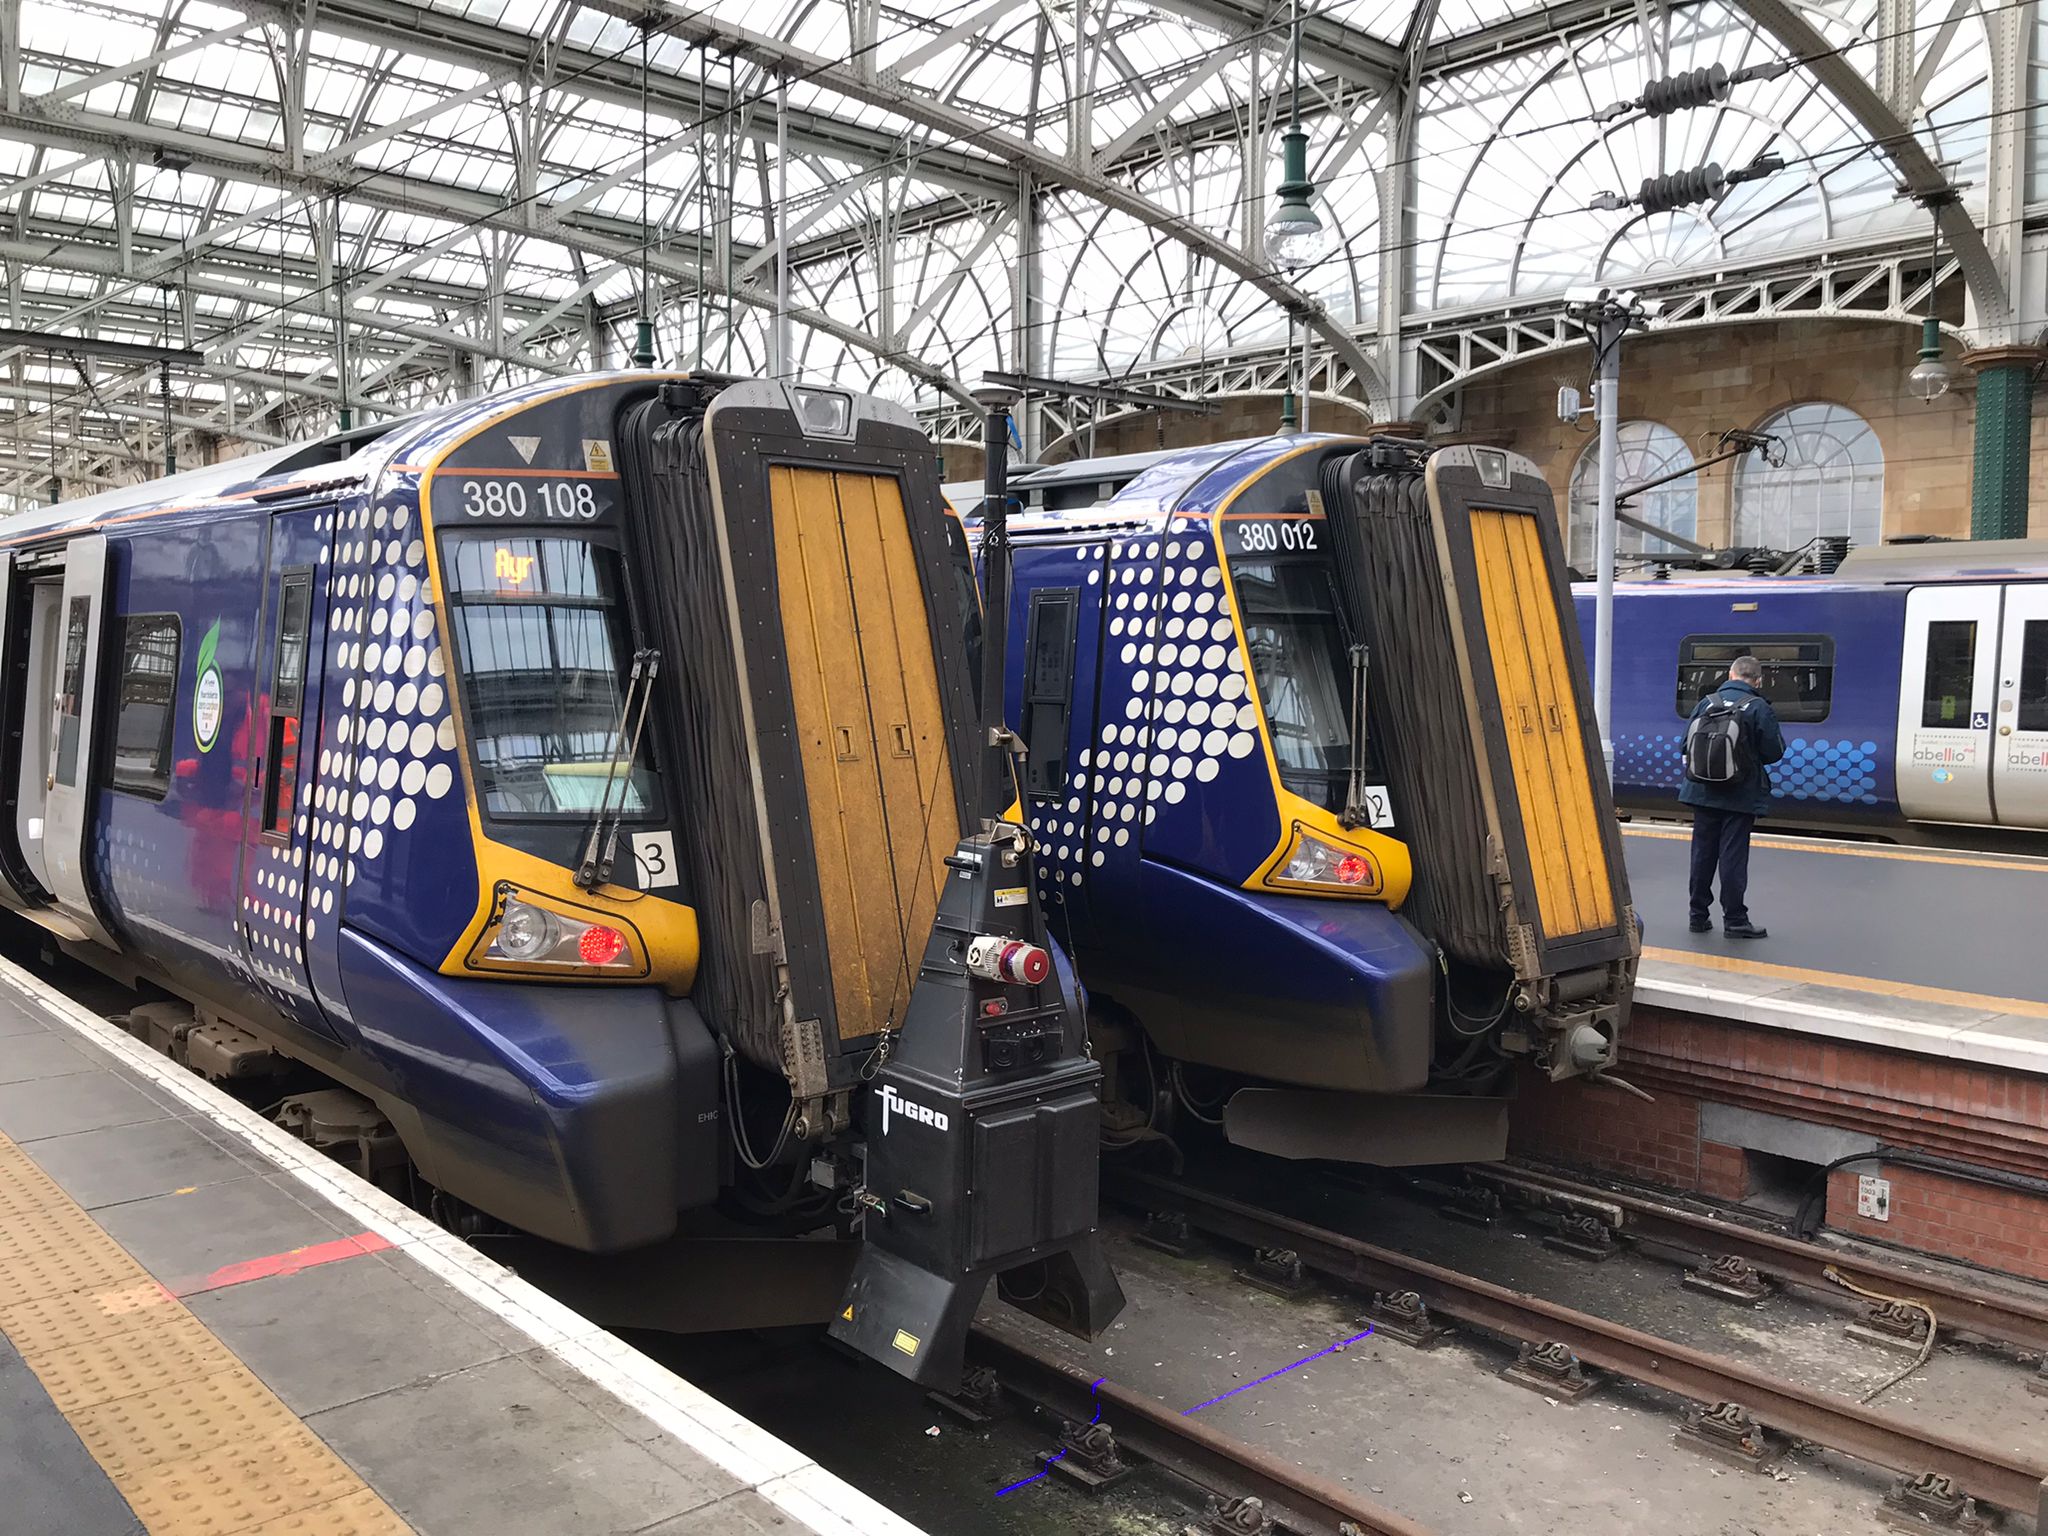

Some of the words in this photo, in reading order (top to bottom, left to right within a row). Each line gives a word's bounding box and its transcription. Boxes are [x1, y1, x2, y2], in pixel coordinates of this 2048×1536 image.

[463, 481, 527, 517] 380
[537, 483, 597, 518] 108
[1238, 523, 1277, 551] 380
[1281, 522, 1318, 550] 012
[495, 548, 534, 584] Ayr
[1914, 747, 1966, 762] abellio
[1372, 794, 1387, 818] 2
[645, 843, 666, 875] 3
